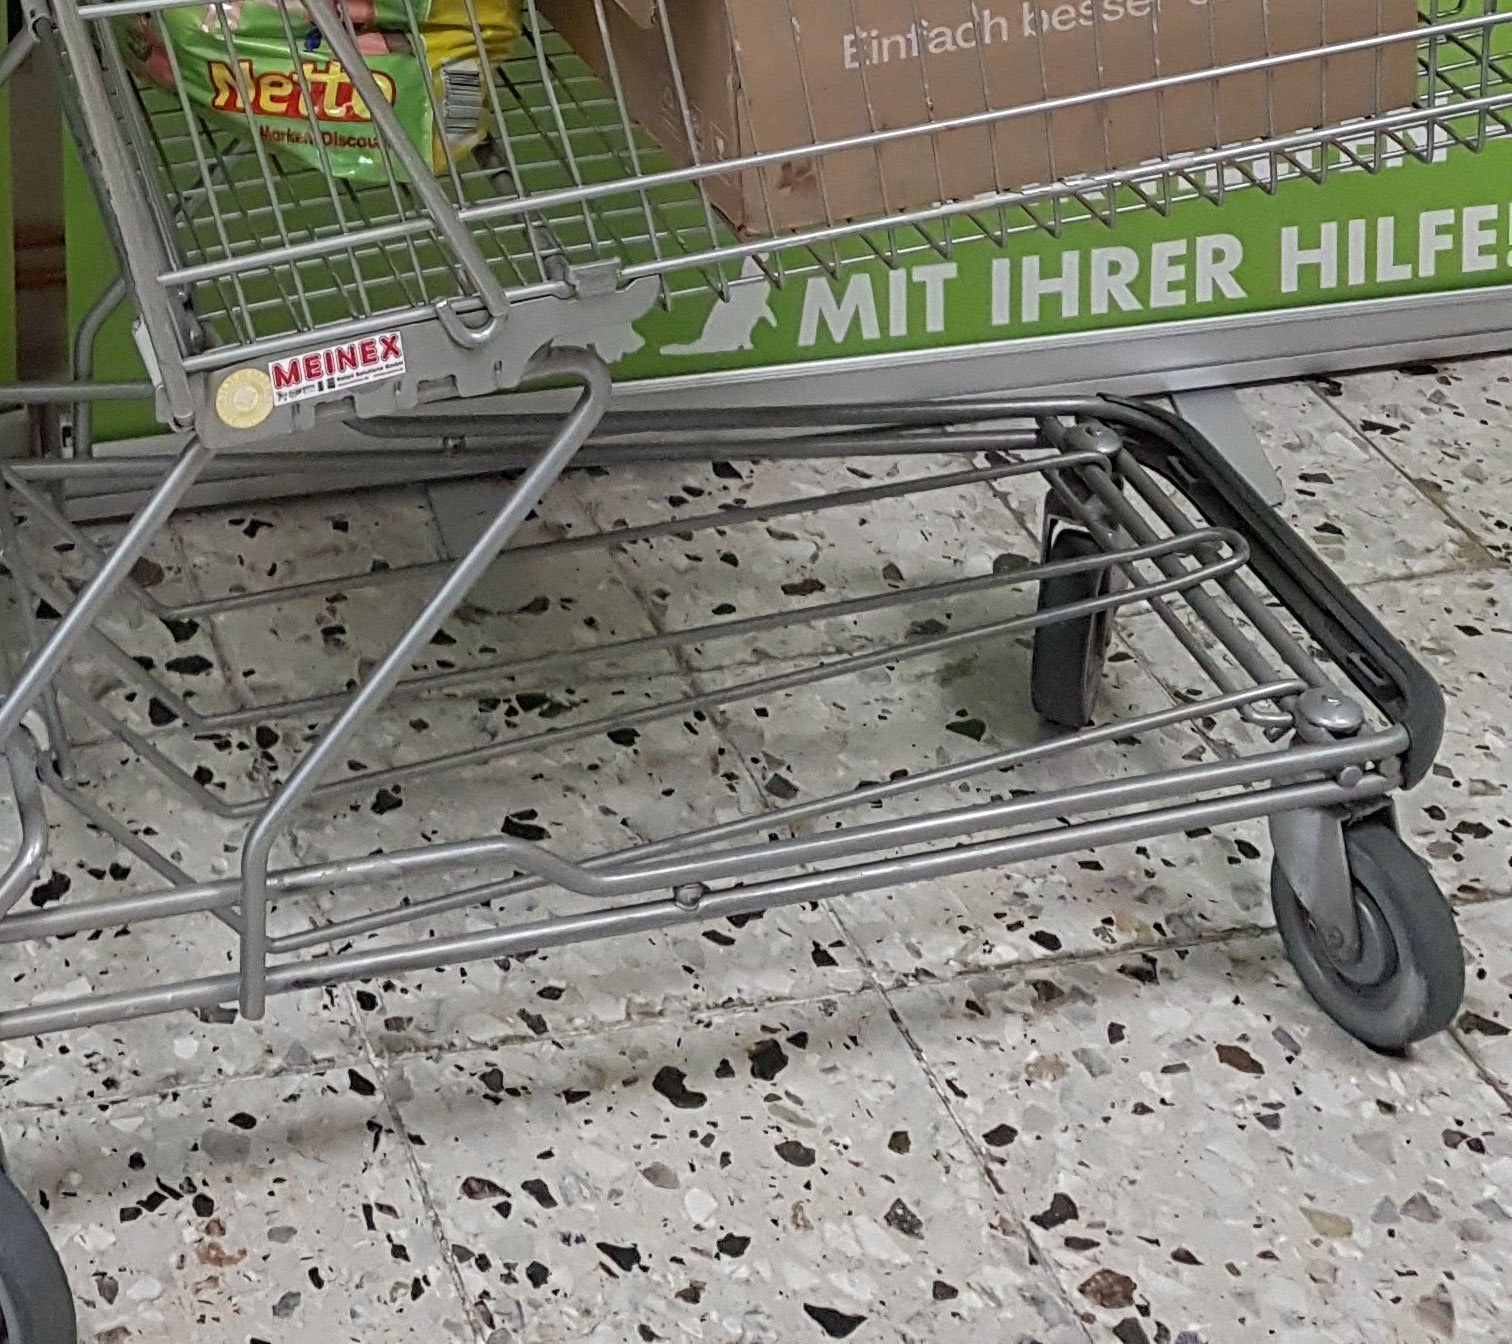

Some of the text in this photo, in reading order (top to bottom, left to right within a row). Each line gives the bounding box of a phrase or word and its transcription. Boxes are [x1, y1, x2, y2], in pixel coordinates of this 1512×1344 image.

[843, 4, 1009, 70] Einfach
[797, 262, 957, 346] MIT
[992, 233, 1247, 326] IHRER
[272, 333, 402, 390] MEINEX
